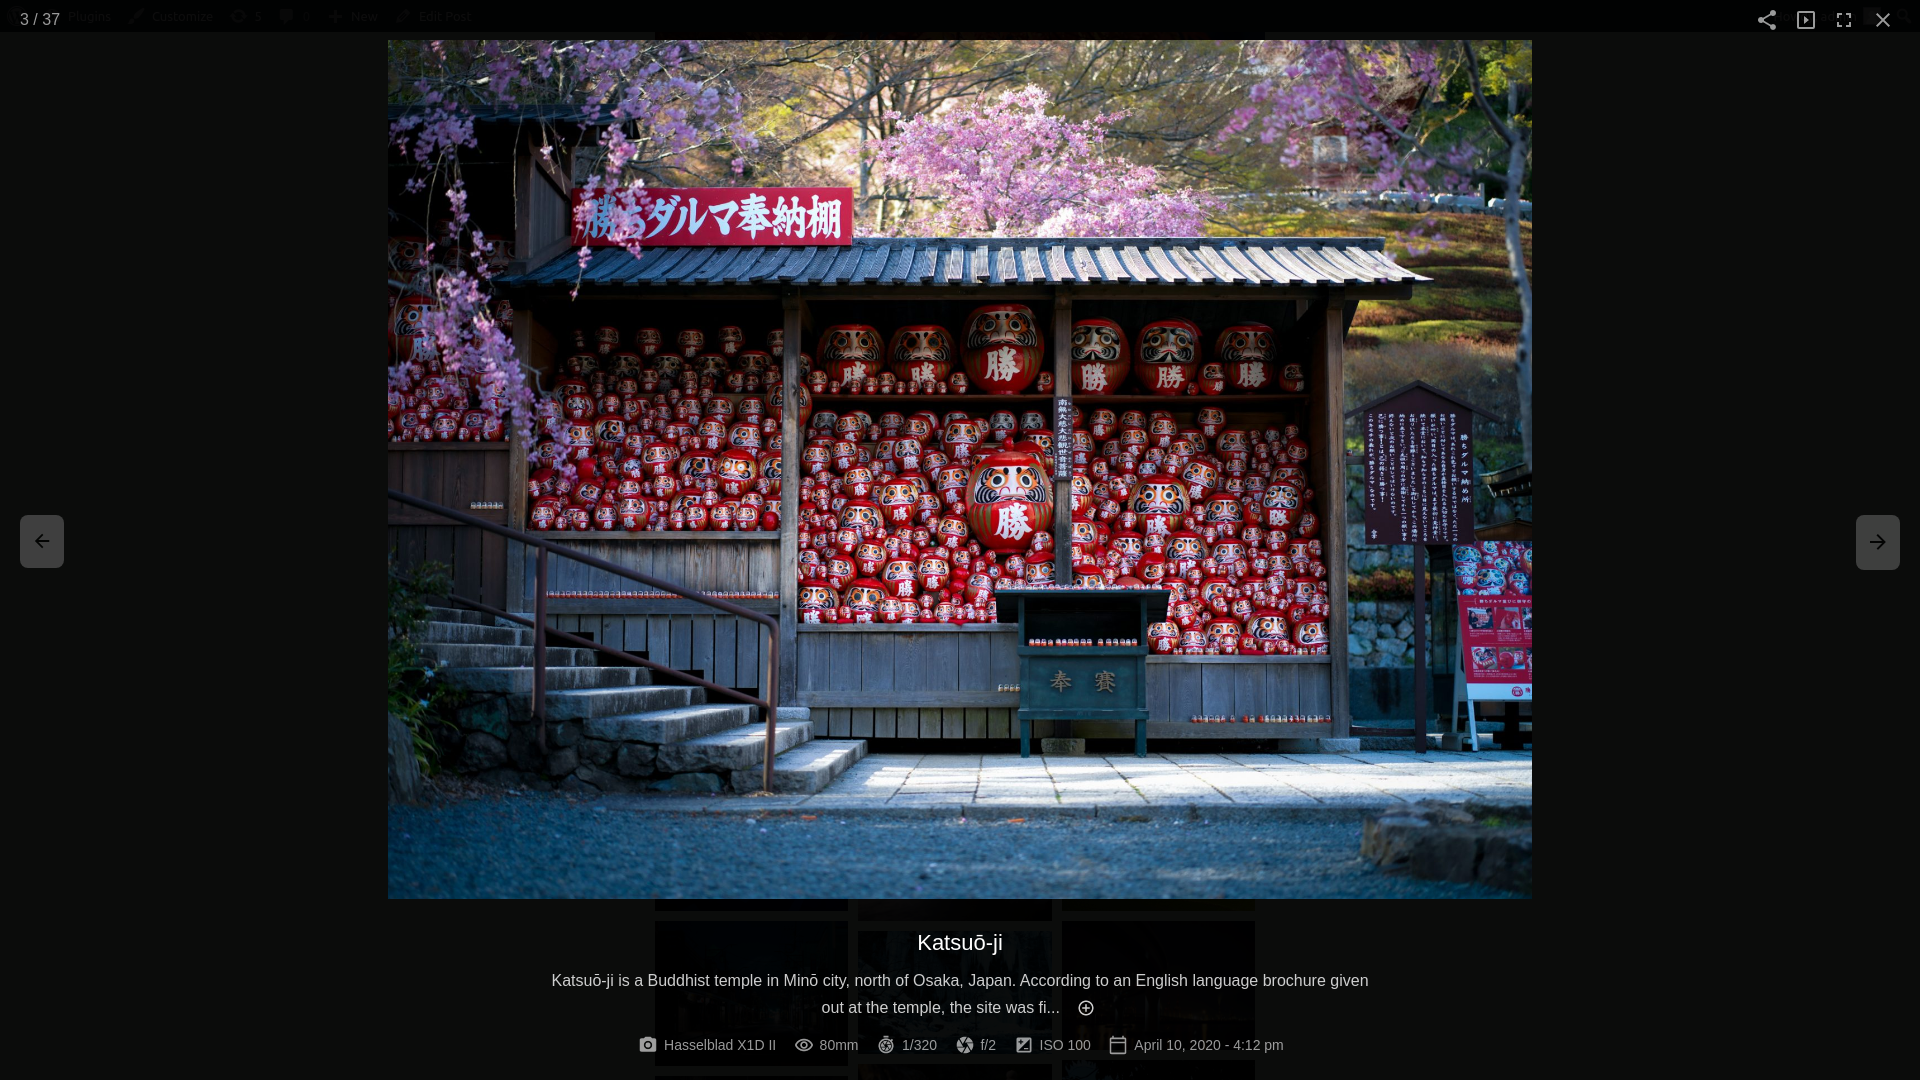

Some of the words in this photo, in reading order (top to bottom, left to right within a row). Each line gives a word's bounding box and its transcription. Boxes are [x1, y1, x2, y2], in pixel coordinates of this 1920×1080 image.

[984, 346, 1021, 382] 勝
[1081, 362, 1109, 392] 勝
[1156, 364, 1186, 389] 勝
[1237, 361, 1267, 388] 勝
[994, 502, 1034, 541] 勝
